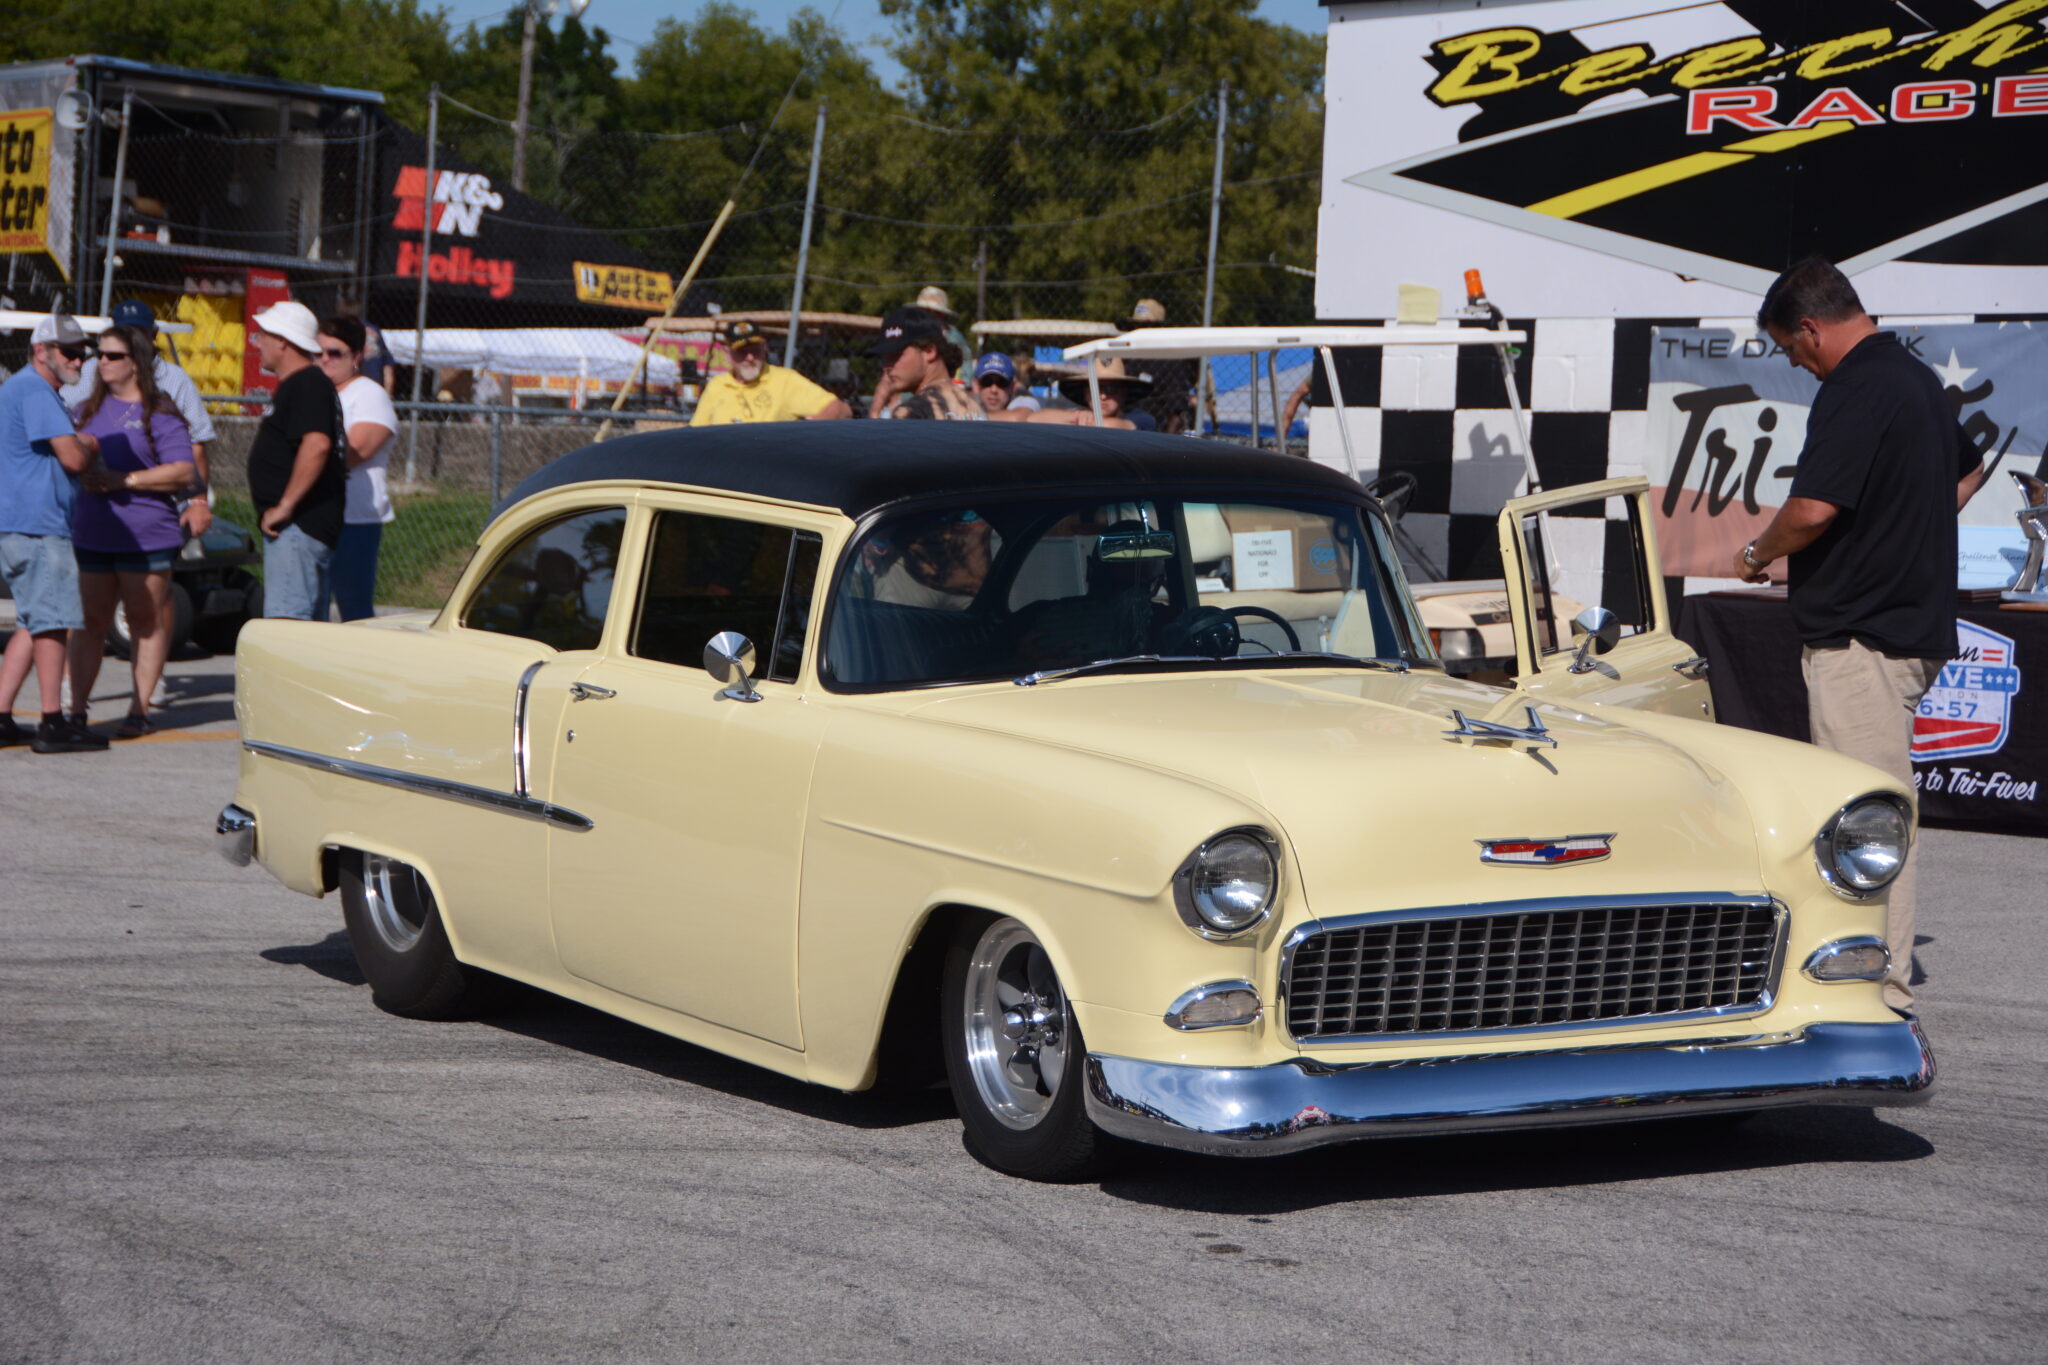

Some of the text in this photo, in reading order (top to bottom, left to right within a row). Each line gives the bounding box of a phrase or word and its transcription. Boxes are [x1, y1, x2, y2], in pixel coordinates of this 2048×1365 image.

[1431, 0, 2048, 102] Beech
[0, 122, 34, 174] to
[1, 180, 45, 230] ter
[396, 239, 515, 299] Holley
[1660, 337, 1730, 359] THE
[1925, 767, 1944, 790] to
[1948, 767, 2038, 801] Tri-Fives
